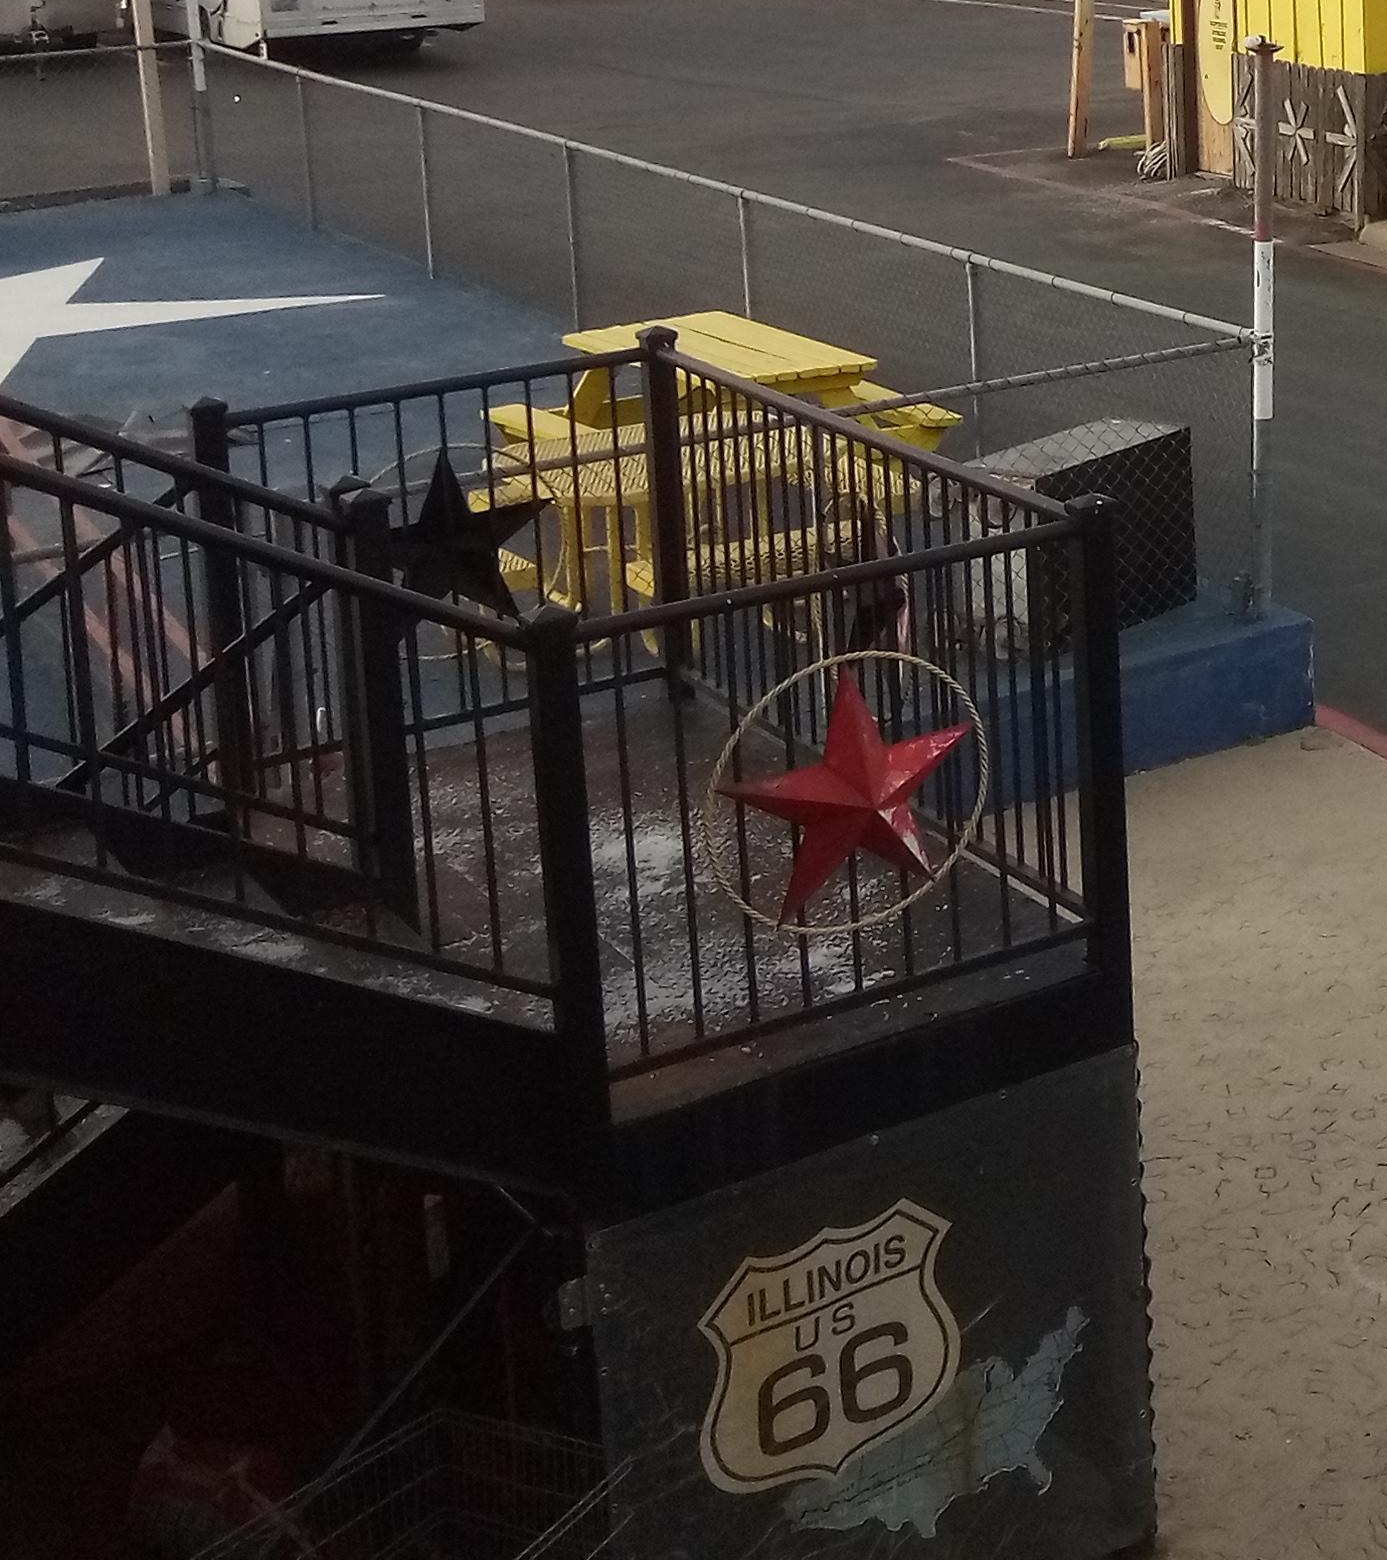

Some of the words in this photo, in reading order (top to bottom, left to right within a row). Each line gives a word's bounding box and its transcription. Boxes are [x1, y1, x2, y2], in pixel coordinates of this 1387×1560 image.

[745, 1234, 908, 1328] ILLINOIS
[794, 1302, 857, 1353] US
[757, 1321, 914, 1457] 66
